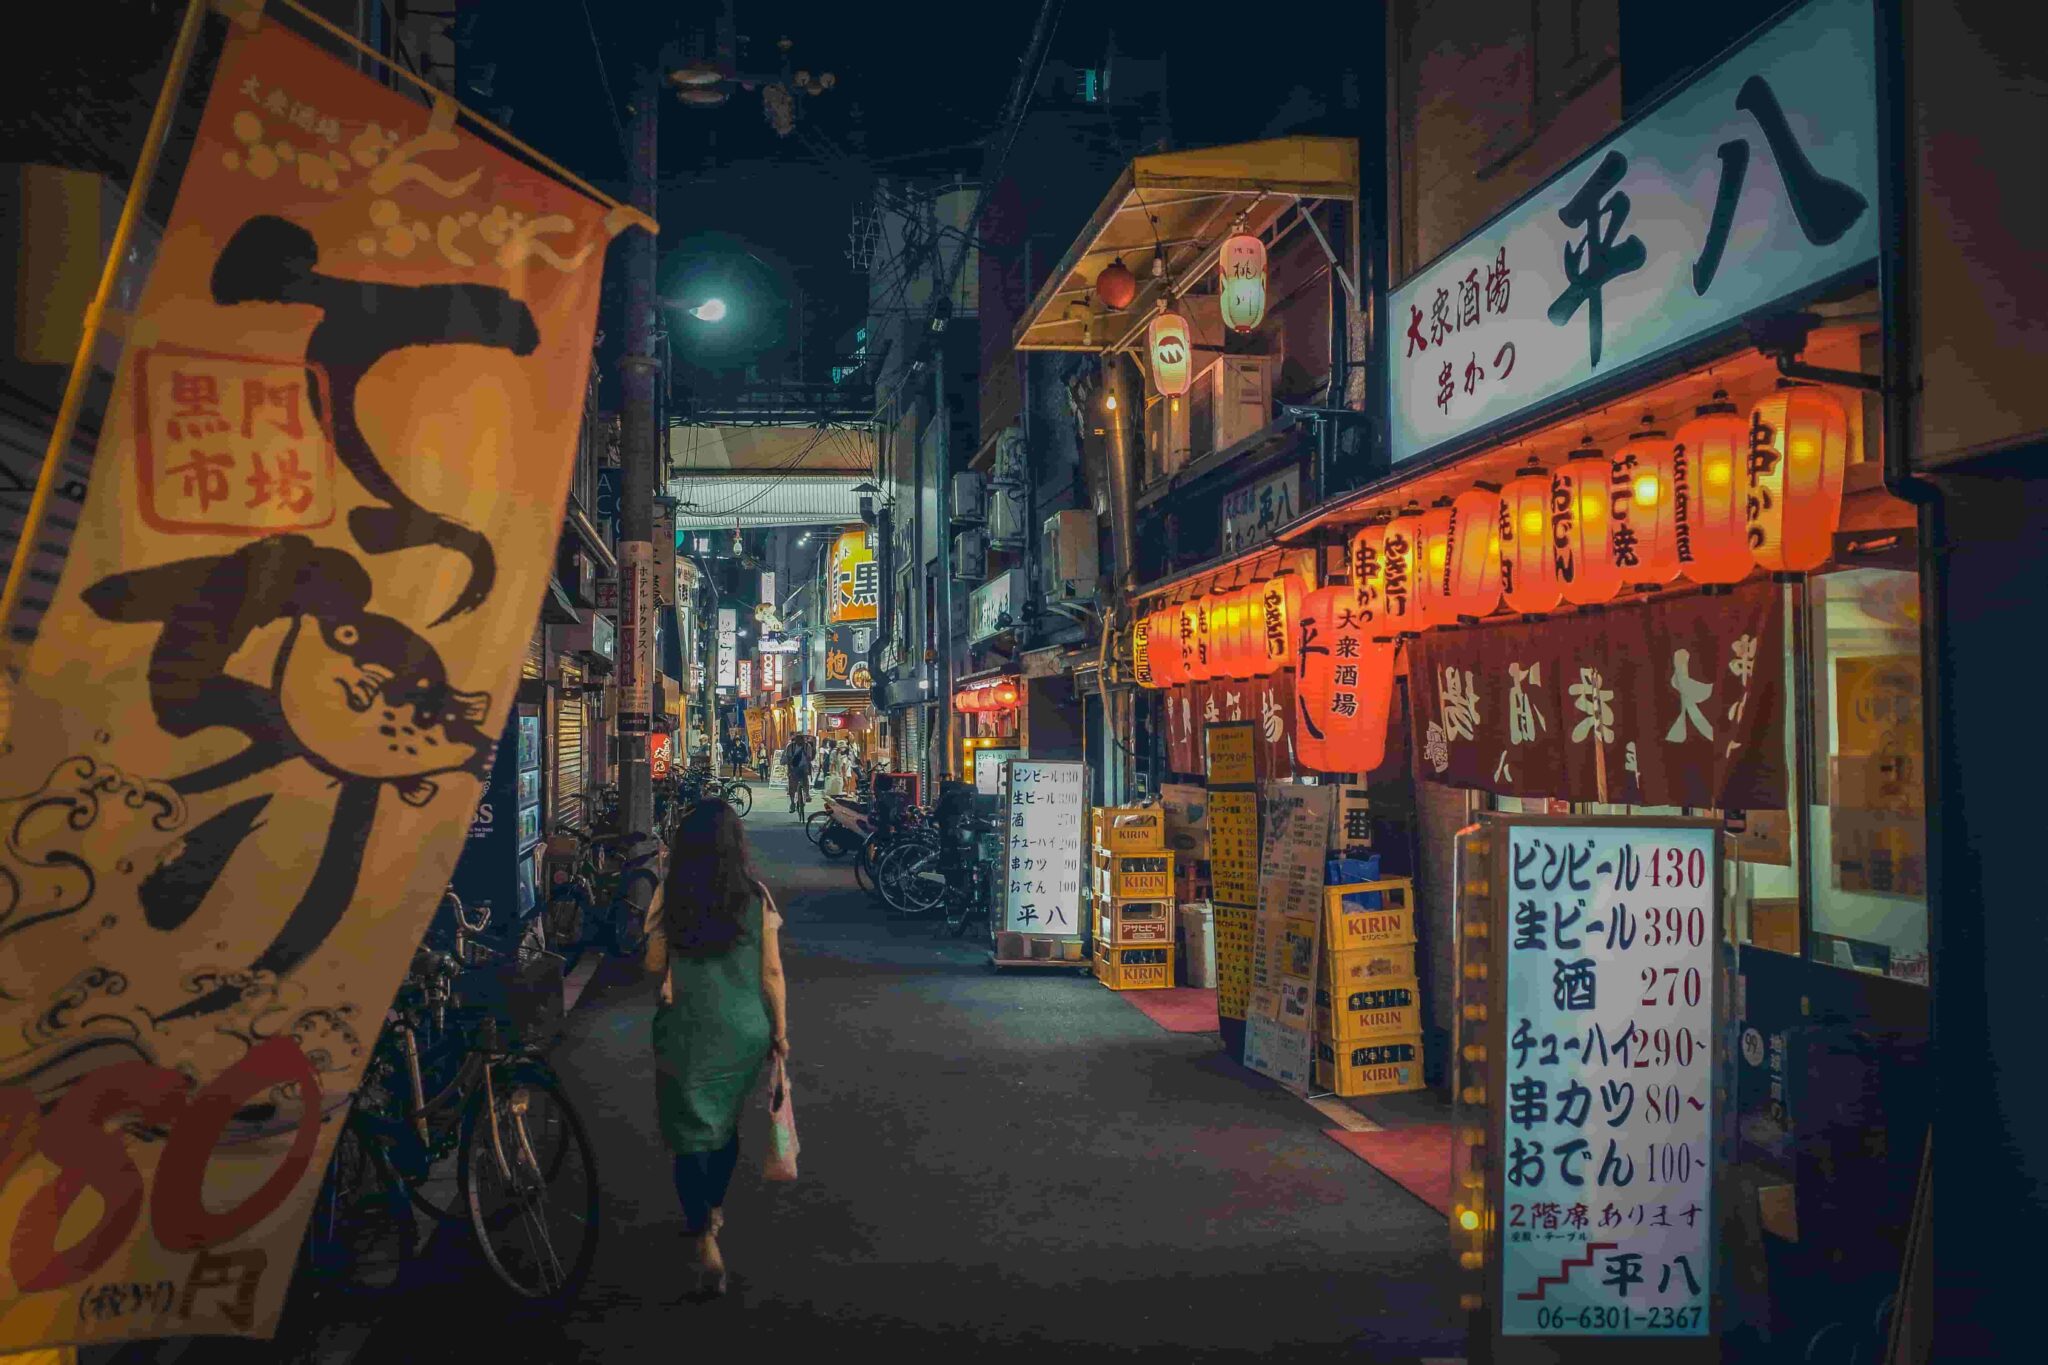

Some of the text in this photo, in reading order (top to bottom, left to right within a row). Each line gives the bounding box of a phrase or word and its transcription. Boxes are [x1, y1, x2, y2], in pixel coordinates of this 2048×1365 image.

[1547, 75, 1870, 375] 平八
[1406, 247, 1511, 358] 大衆酒場
[1437, 341, 1516, 416] 串かつ
[167, 371, 303, 441] 黒門
[165, 449, 315, 514] 市場
[1748, 410, 1782, 550] 串かつ
[1352, 539, 1381, 622] 串かつ
[1331, 608, 1361, 718] 大衆酒場
[1119, 830, 1150, 840] KIRIN
[1010, 880, 1047, 894] おでん
[1125, 877, 1165, 888] KIRIN
[1514, 839, 1706, 892] ビンビール 430
[1016, 904, 1068, 926] 平八
[1122, 923, 1165, 933] アサヒビール
[1348, 915, 1400, 937] KIRIN
[1514, 899, 1705, 950] 生ビール 390
[1123, 967, 1164, 981] KIRIN
[1552, 957, 1701, 1011] 酒 270
[1360, 1011, 1402, 1028] KIRIN
[1511, 1018, 1635, 1069] チューハイ
[1510, 1075, 1635, 1132] 串カツ
[1508, 1137, 1635, 1188] おでん
[1602, 1253, 1701, 1298] 平八
[1537, 1305, 1702, 1330] 06-6301-2367
